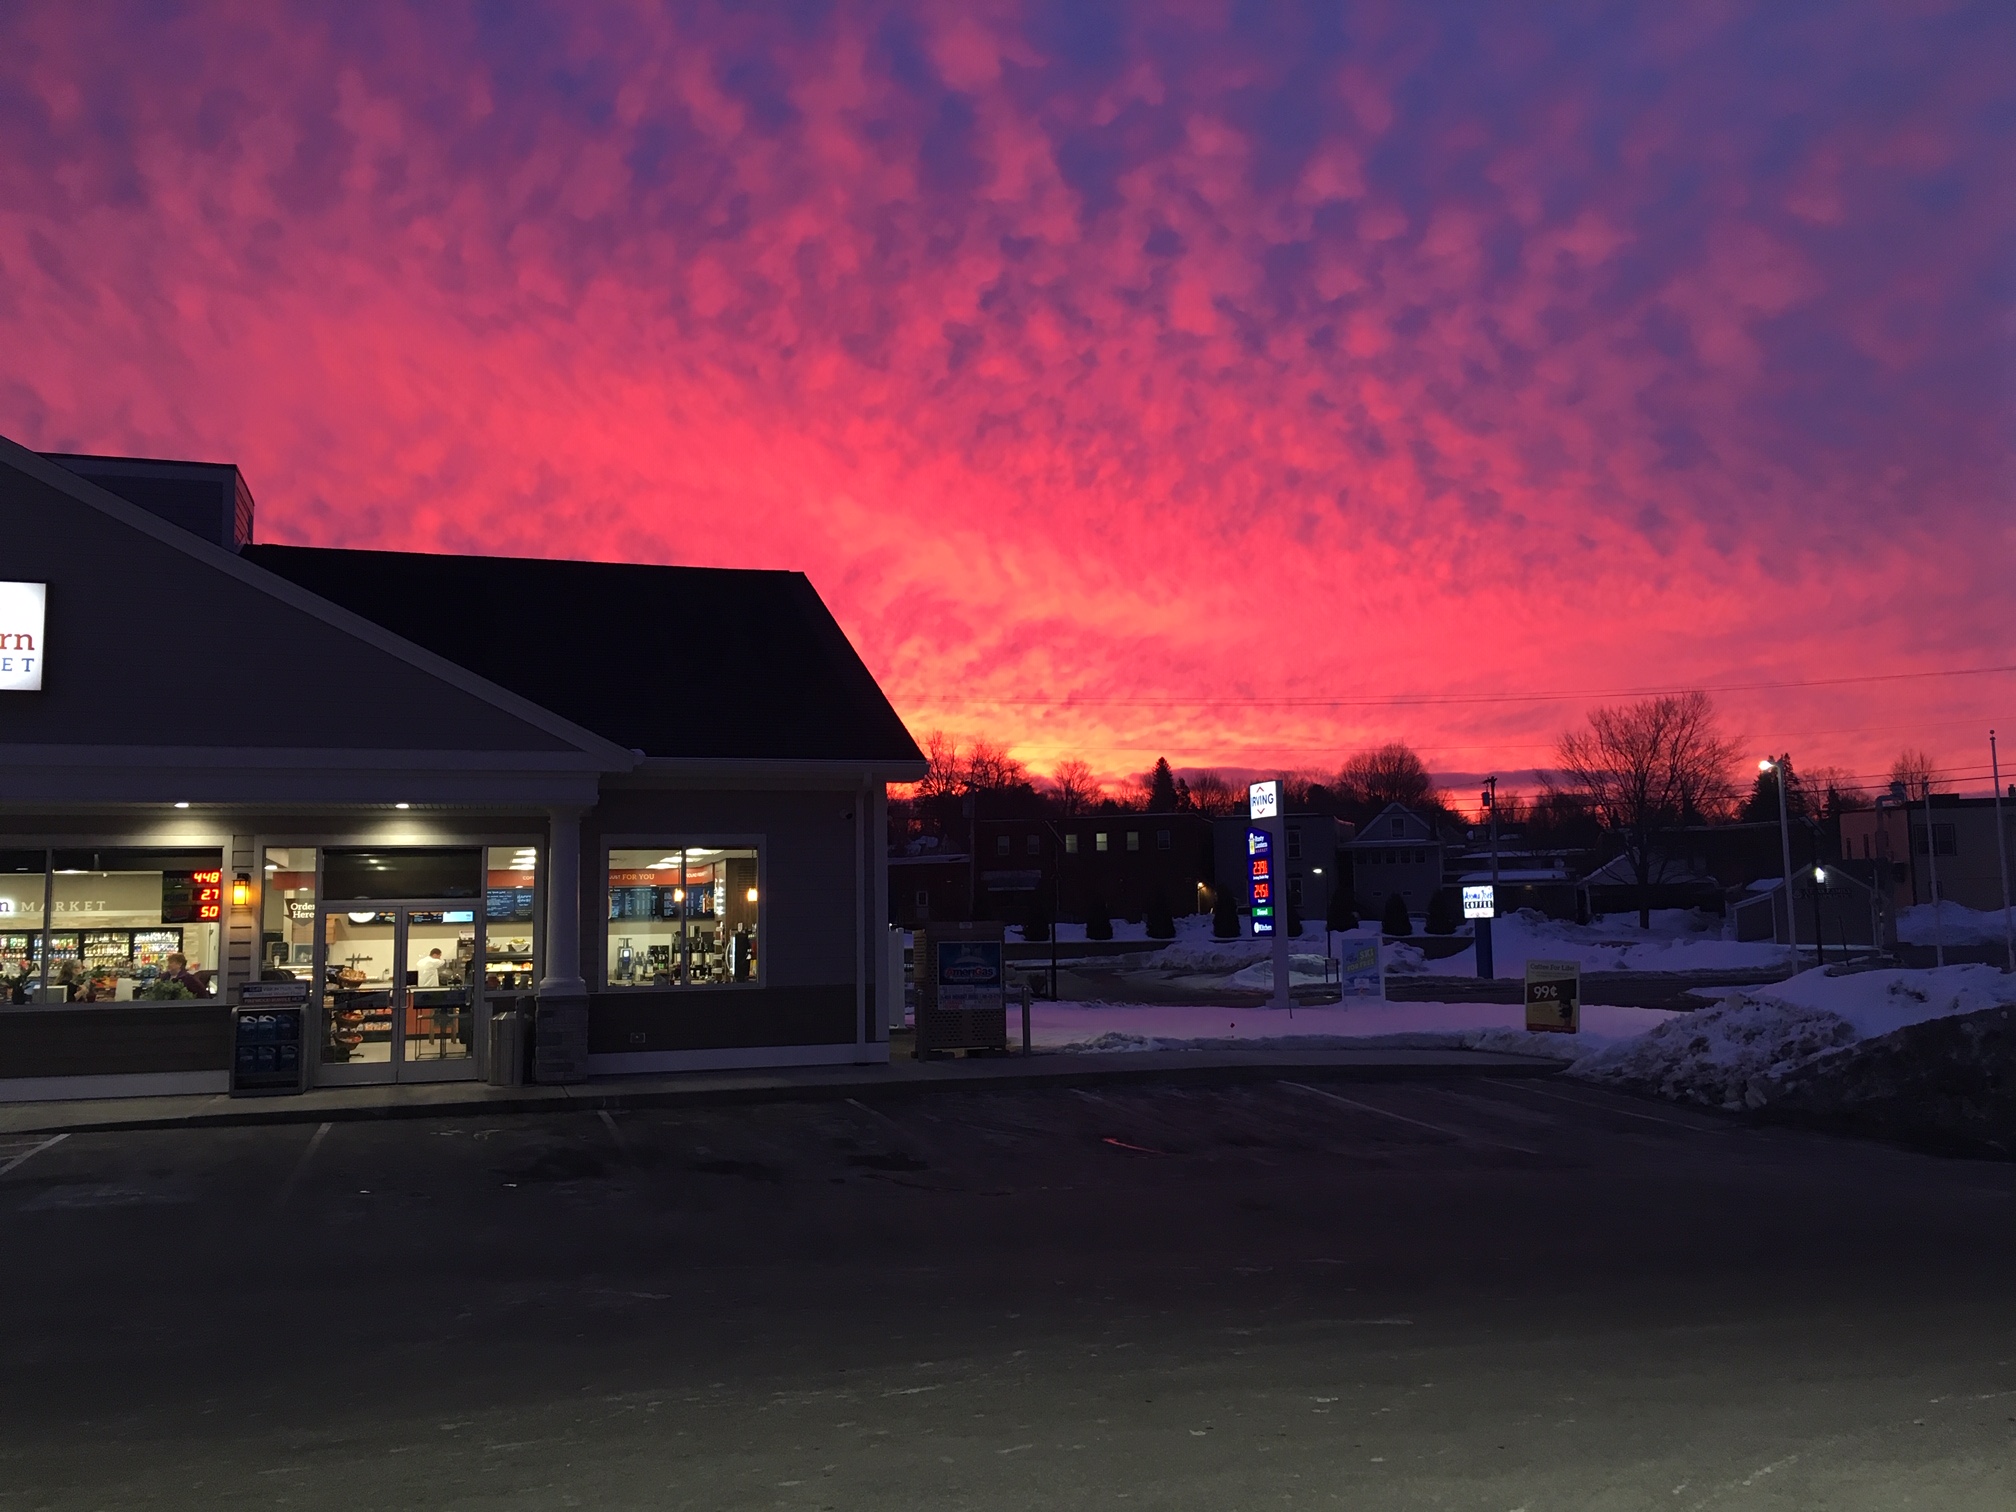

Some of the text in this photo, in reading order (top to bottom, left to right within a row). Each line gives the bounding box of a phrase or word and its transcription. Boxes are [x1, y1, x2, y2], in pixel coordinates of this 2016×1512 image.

[193, 872, 220, 883] 448
[200, 906, 219, 918] 50
[292, 910, 315, 919] Here
[946, 967, 994, 977] AmeriGas
[1530, 963, 1549, 971] Coffee
[1550, 963, 1560, 971] For
[1533, 985, 1558, 1000] 99¢
